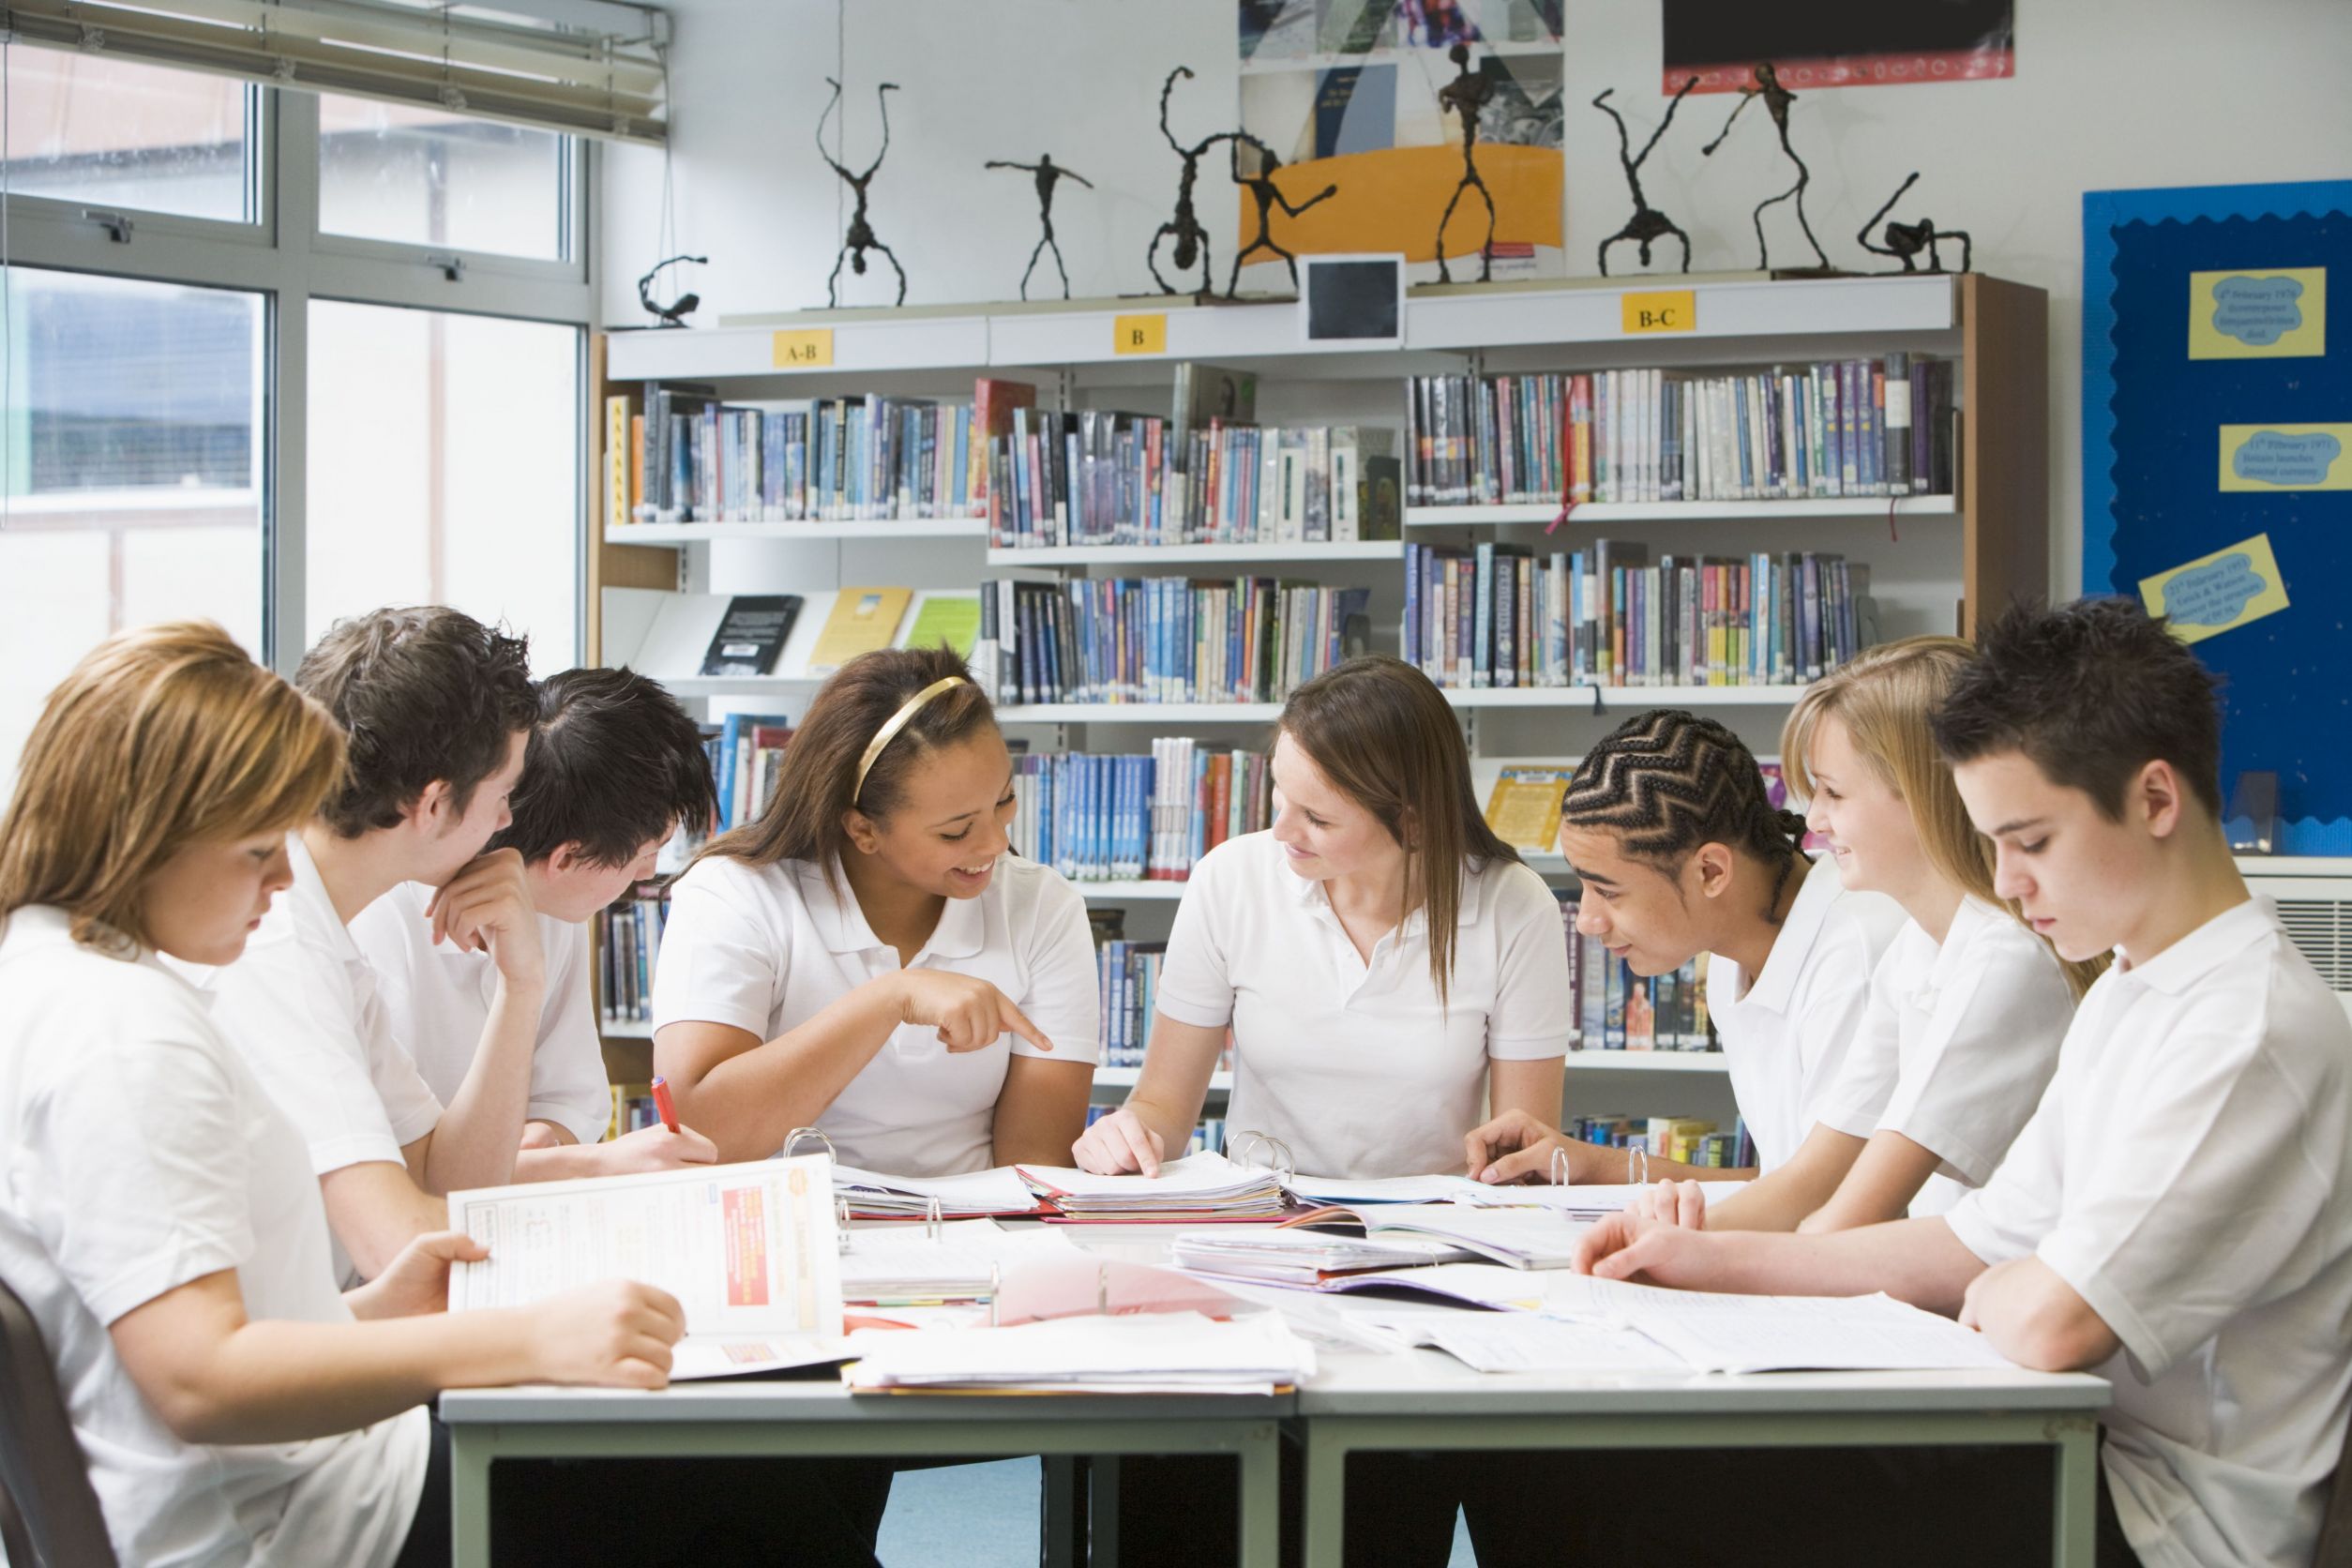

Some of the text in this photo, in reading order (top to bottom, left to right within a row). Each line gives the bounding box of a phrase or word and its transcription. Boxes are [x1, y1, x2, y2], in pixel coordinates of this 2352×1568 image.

[1639, 308, 1676, 328] B-C
[1132, 328, 1144, 346] B
[786, 344, 817, 361] A-B
